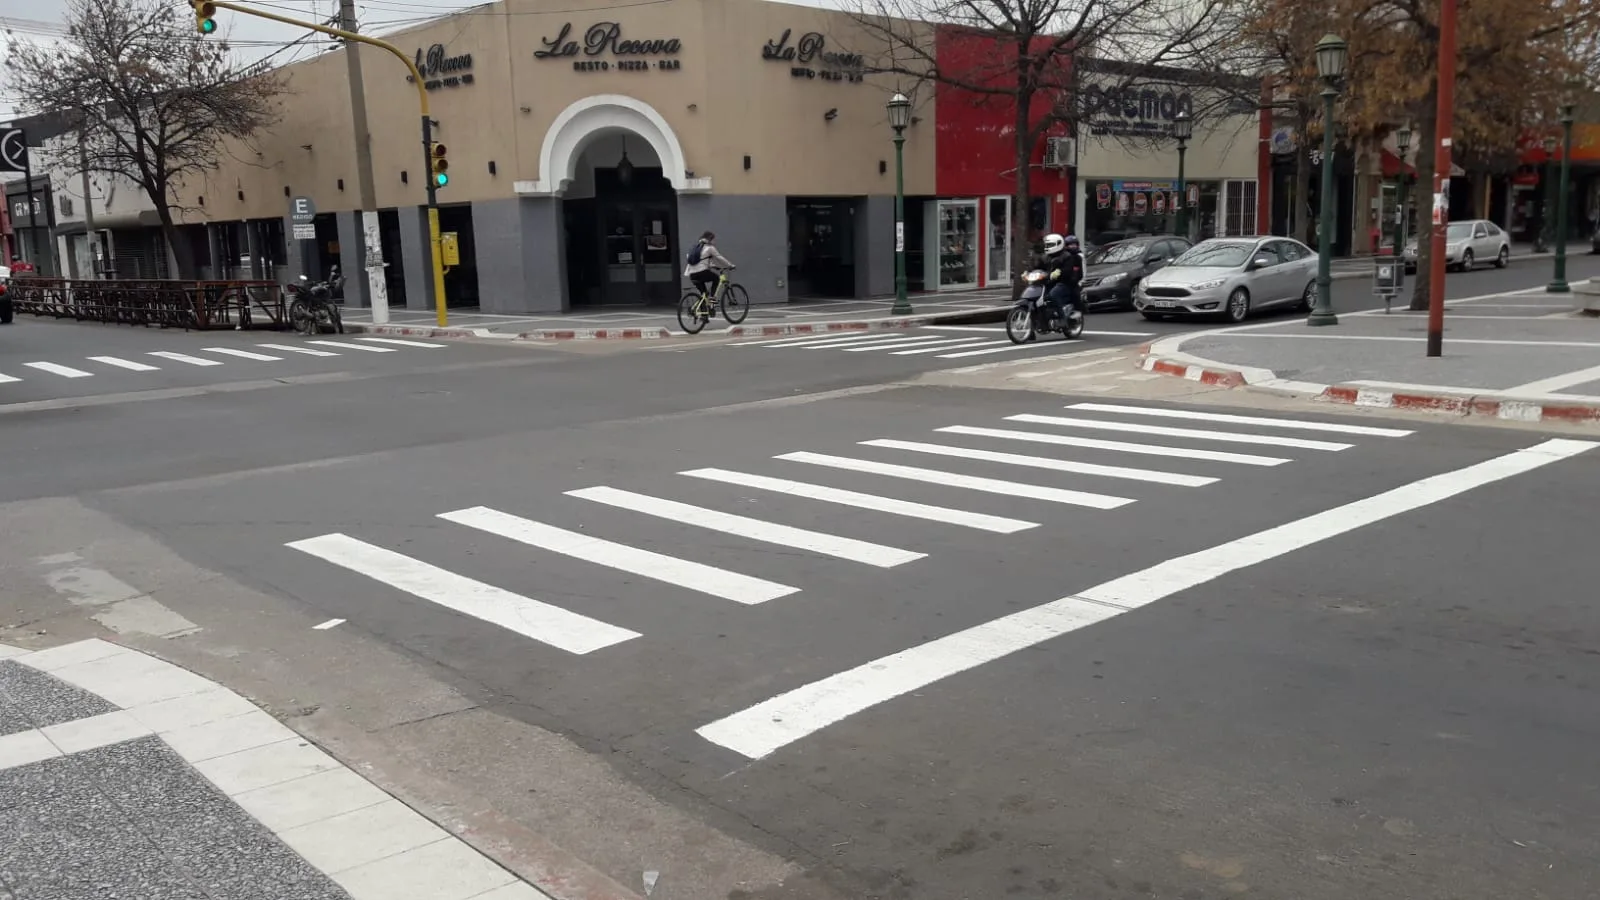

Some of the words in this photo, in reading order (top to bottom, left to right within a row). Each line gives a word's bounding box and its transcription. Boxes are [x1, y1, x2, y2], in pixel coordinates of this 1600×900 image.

[534, 22, 580, 57] La
[584, 21, 681, 55] Recova
[763, 28, 796, 59] La
[573, 61, 608, 71] RESTO
[618, 61, 648, 71] PIZZA
[659, 60, 680, 70] BAR
[295, 198, 308, 213] E
